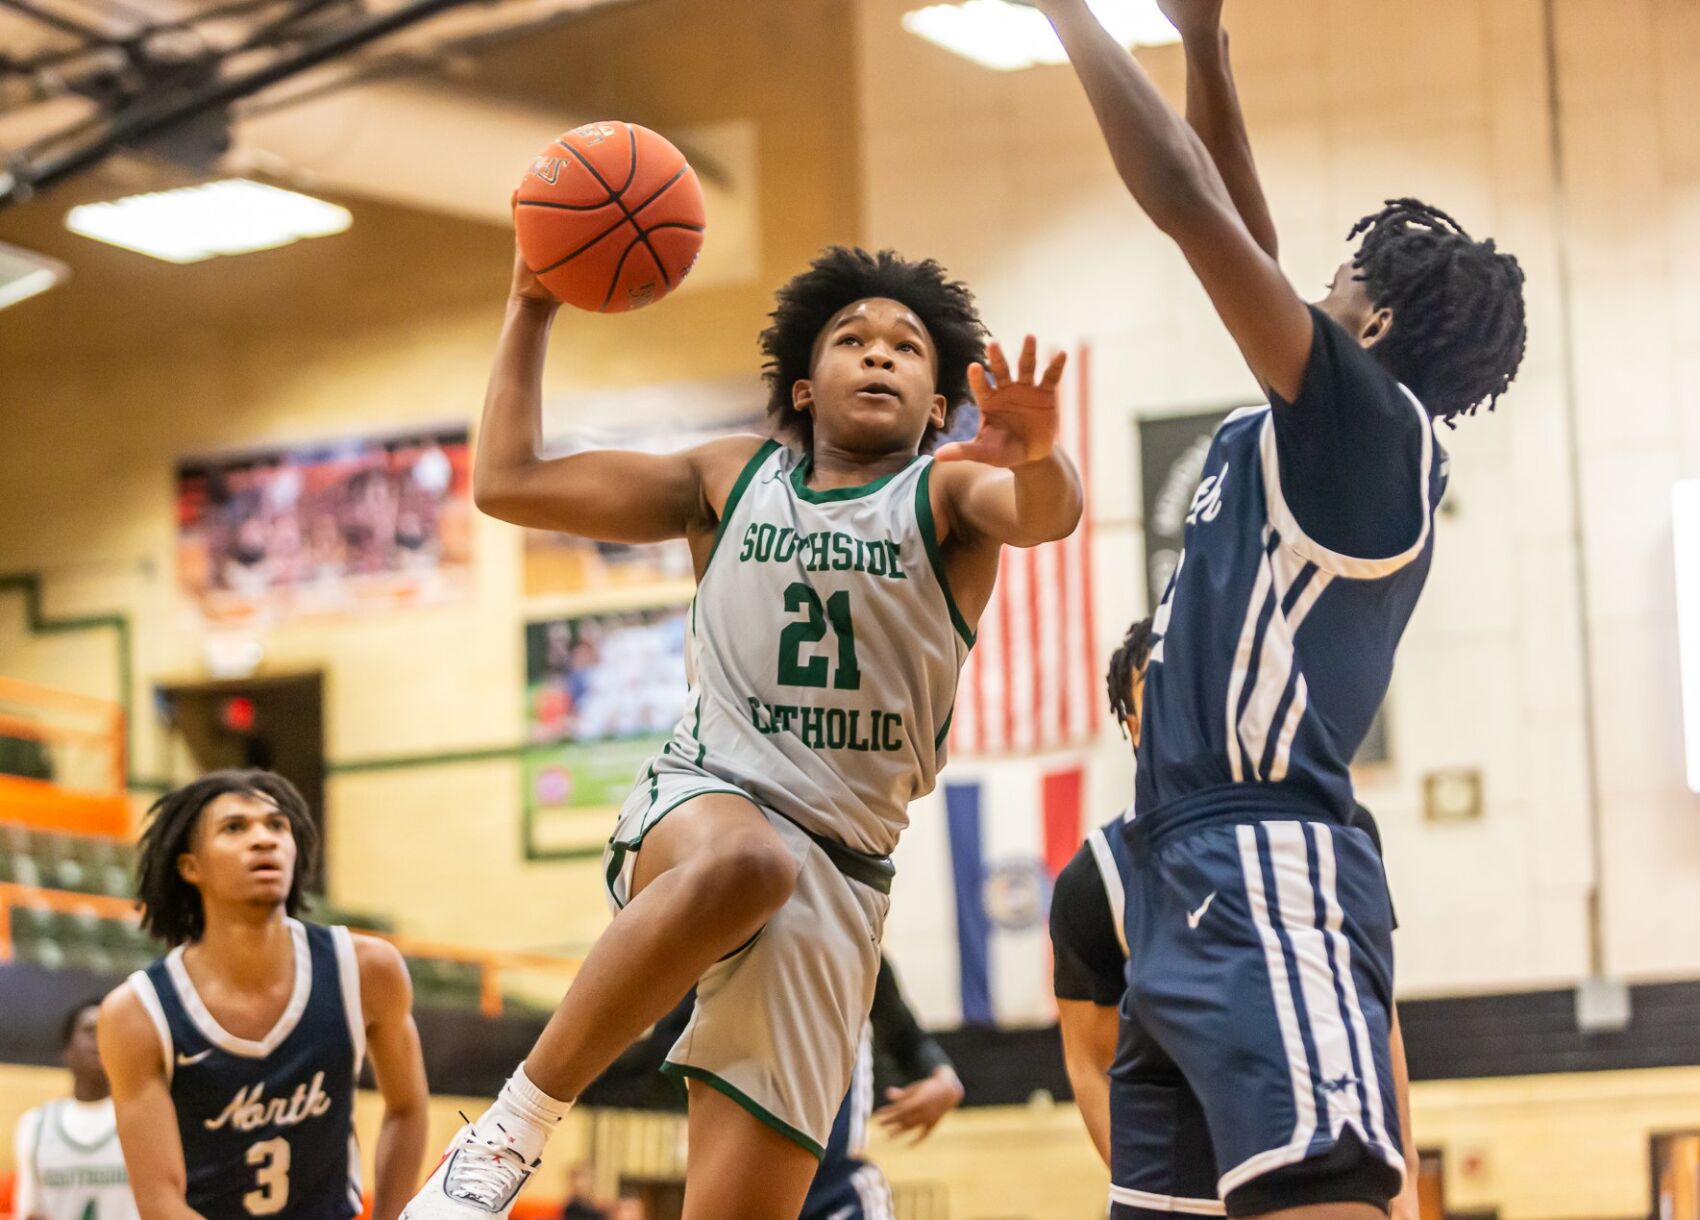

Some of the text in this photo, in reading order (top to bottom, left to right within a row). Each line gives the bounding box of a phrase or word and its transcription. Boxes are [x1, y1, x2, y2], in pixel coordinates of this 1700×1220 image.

[777, 582, 861, 690] 21
[203, 1070, 332, 1132] North
[243, 1136, 291, 1216] 3
